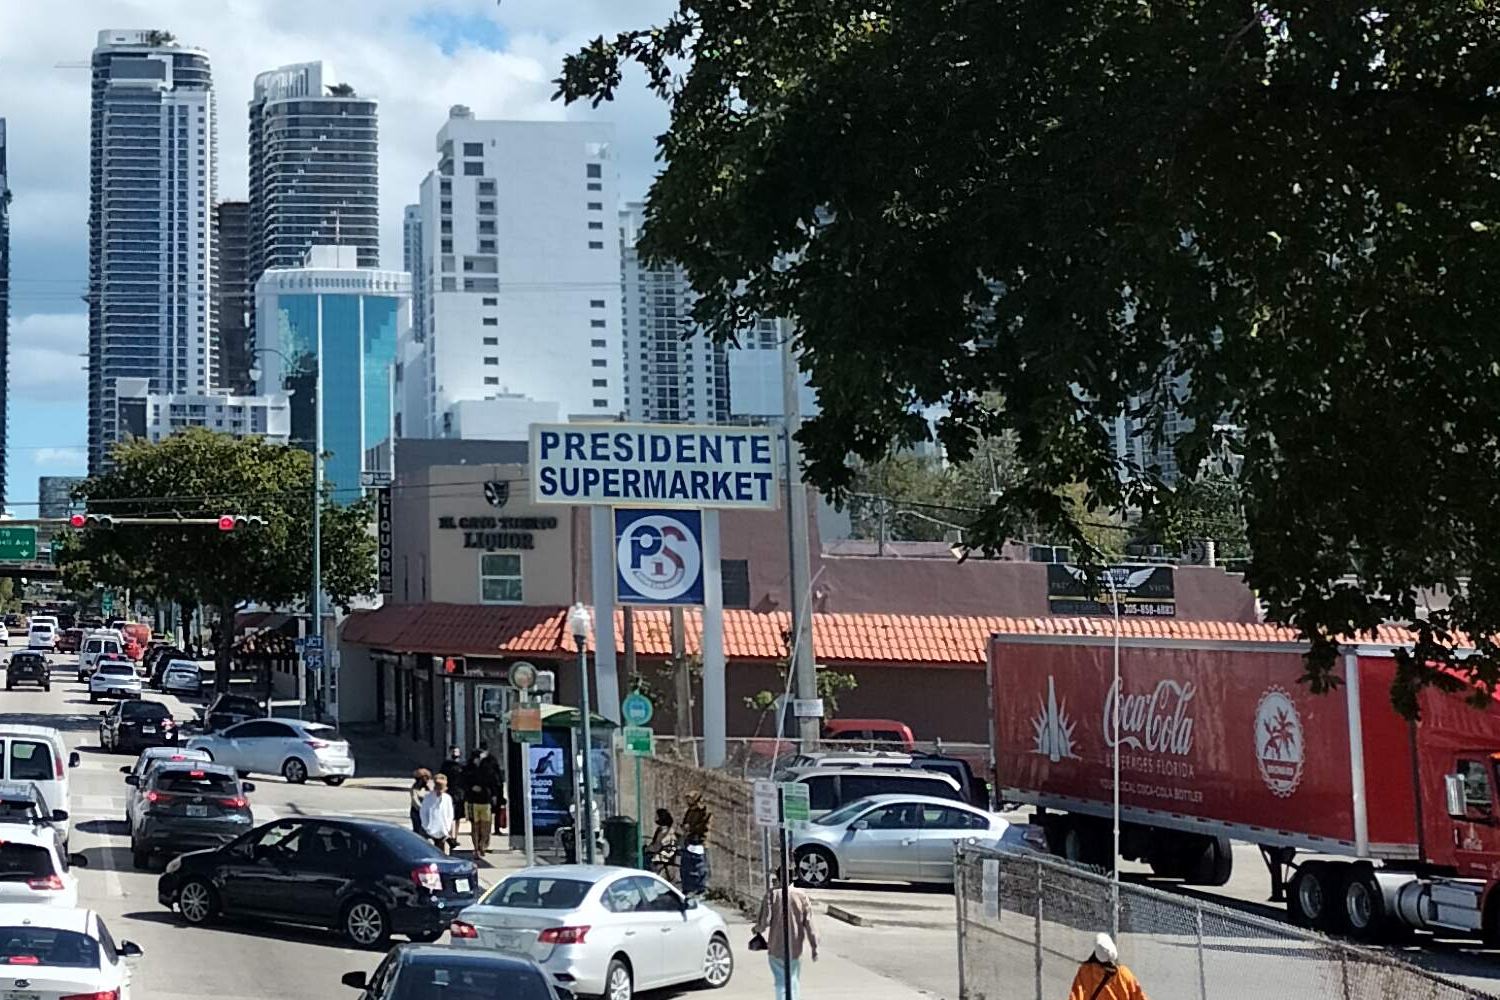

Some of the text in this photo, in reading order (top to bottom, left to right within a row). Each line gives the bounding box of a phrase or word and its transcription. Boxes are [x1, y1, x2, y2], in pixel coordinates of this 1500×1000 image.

[540, 431, 771, 464] PRESIDENTE
[540, 466, 773, 501] SUPERMARKET
[463, 532, 535, 552] LIQUOR
[306, 637, 322, 647] JCT
[307, 655, 321, 667] 95
[1105, 753, 1195, 779] BEERAGES FLORIDA
